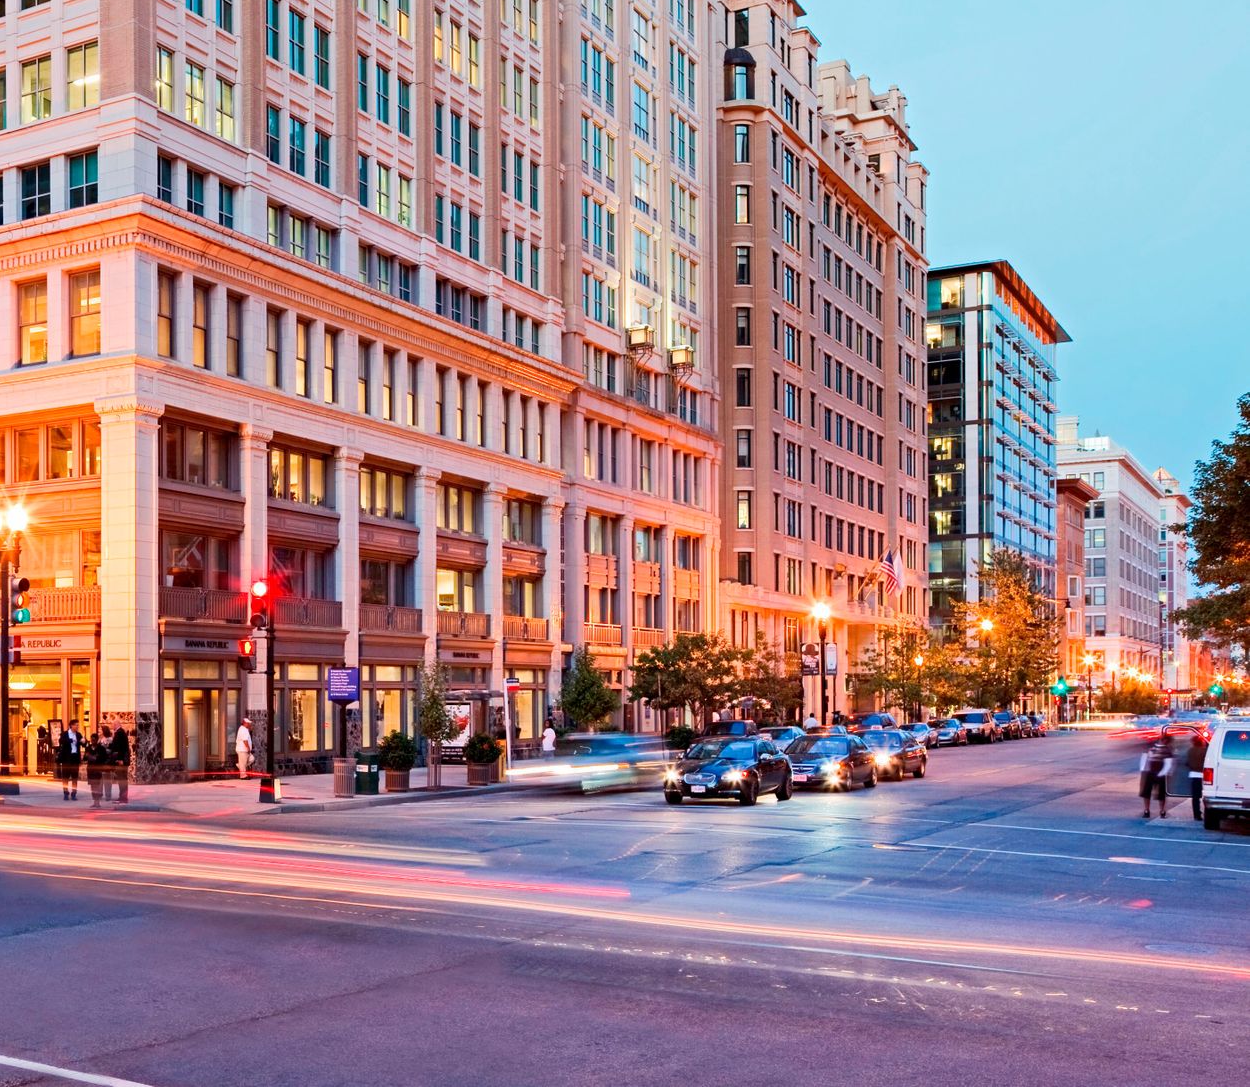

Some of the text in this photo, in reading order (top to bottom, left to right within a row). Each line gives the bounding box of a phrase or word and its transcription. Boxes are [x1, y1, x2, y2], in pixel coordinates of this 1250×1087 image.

[27, 639, 62, 648] REPUBLIC
[184, 639, 230, 649] BANANA REPUBLIC
